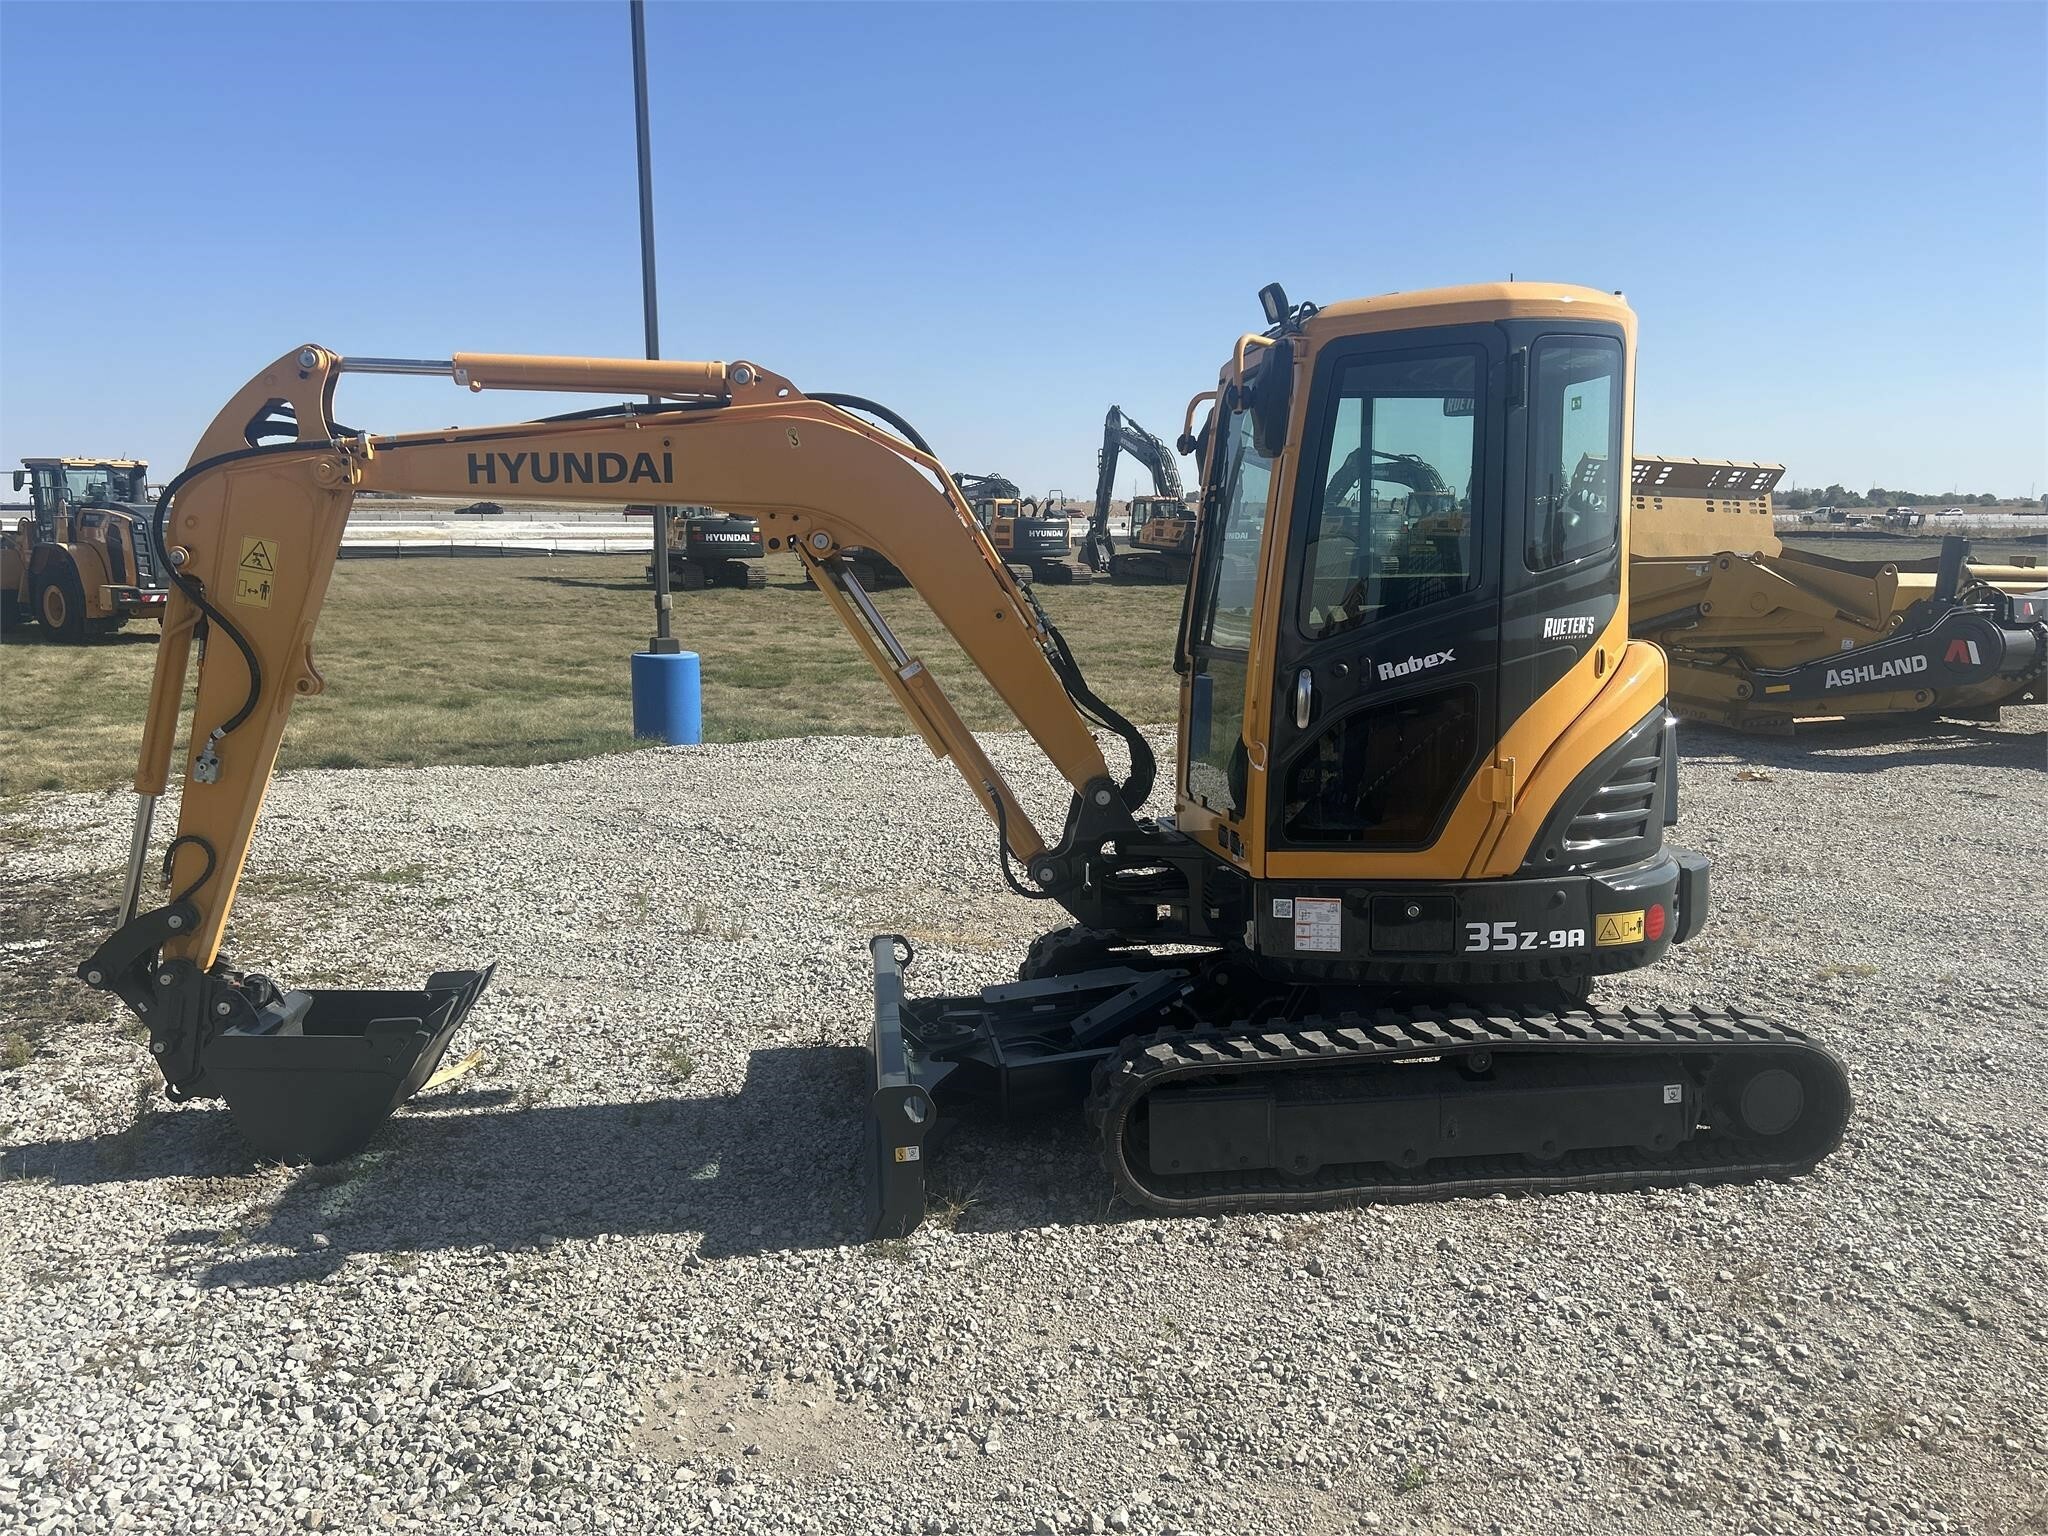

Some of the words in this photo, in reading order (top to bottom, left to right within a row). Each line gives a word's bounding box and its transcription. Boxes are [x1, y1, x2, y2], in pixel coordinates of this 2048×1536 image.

[467, 452, 674, 484] HYUNDAI
[705, 533, 750, 542] HYUNDAI
[1028, 530, 1064, 538] HYUNDAI
[1543, 616, 1595, 639] RUETER'S
[1377, 648, 1457, 681] Robex
[1825, 654, 1928, 689] ASHLAND
